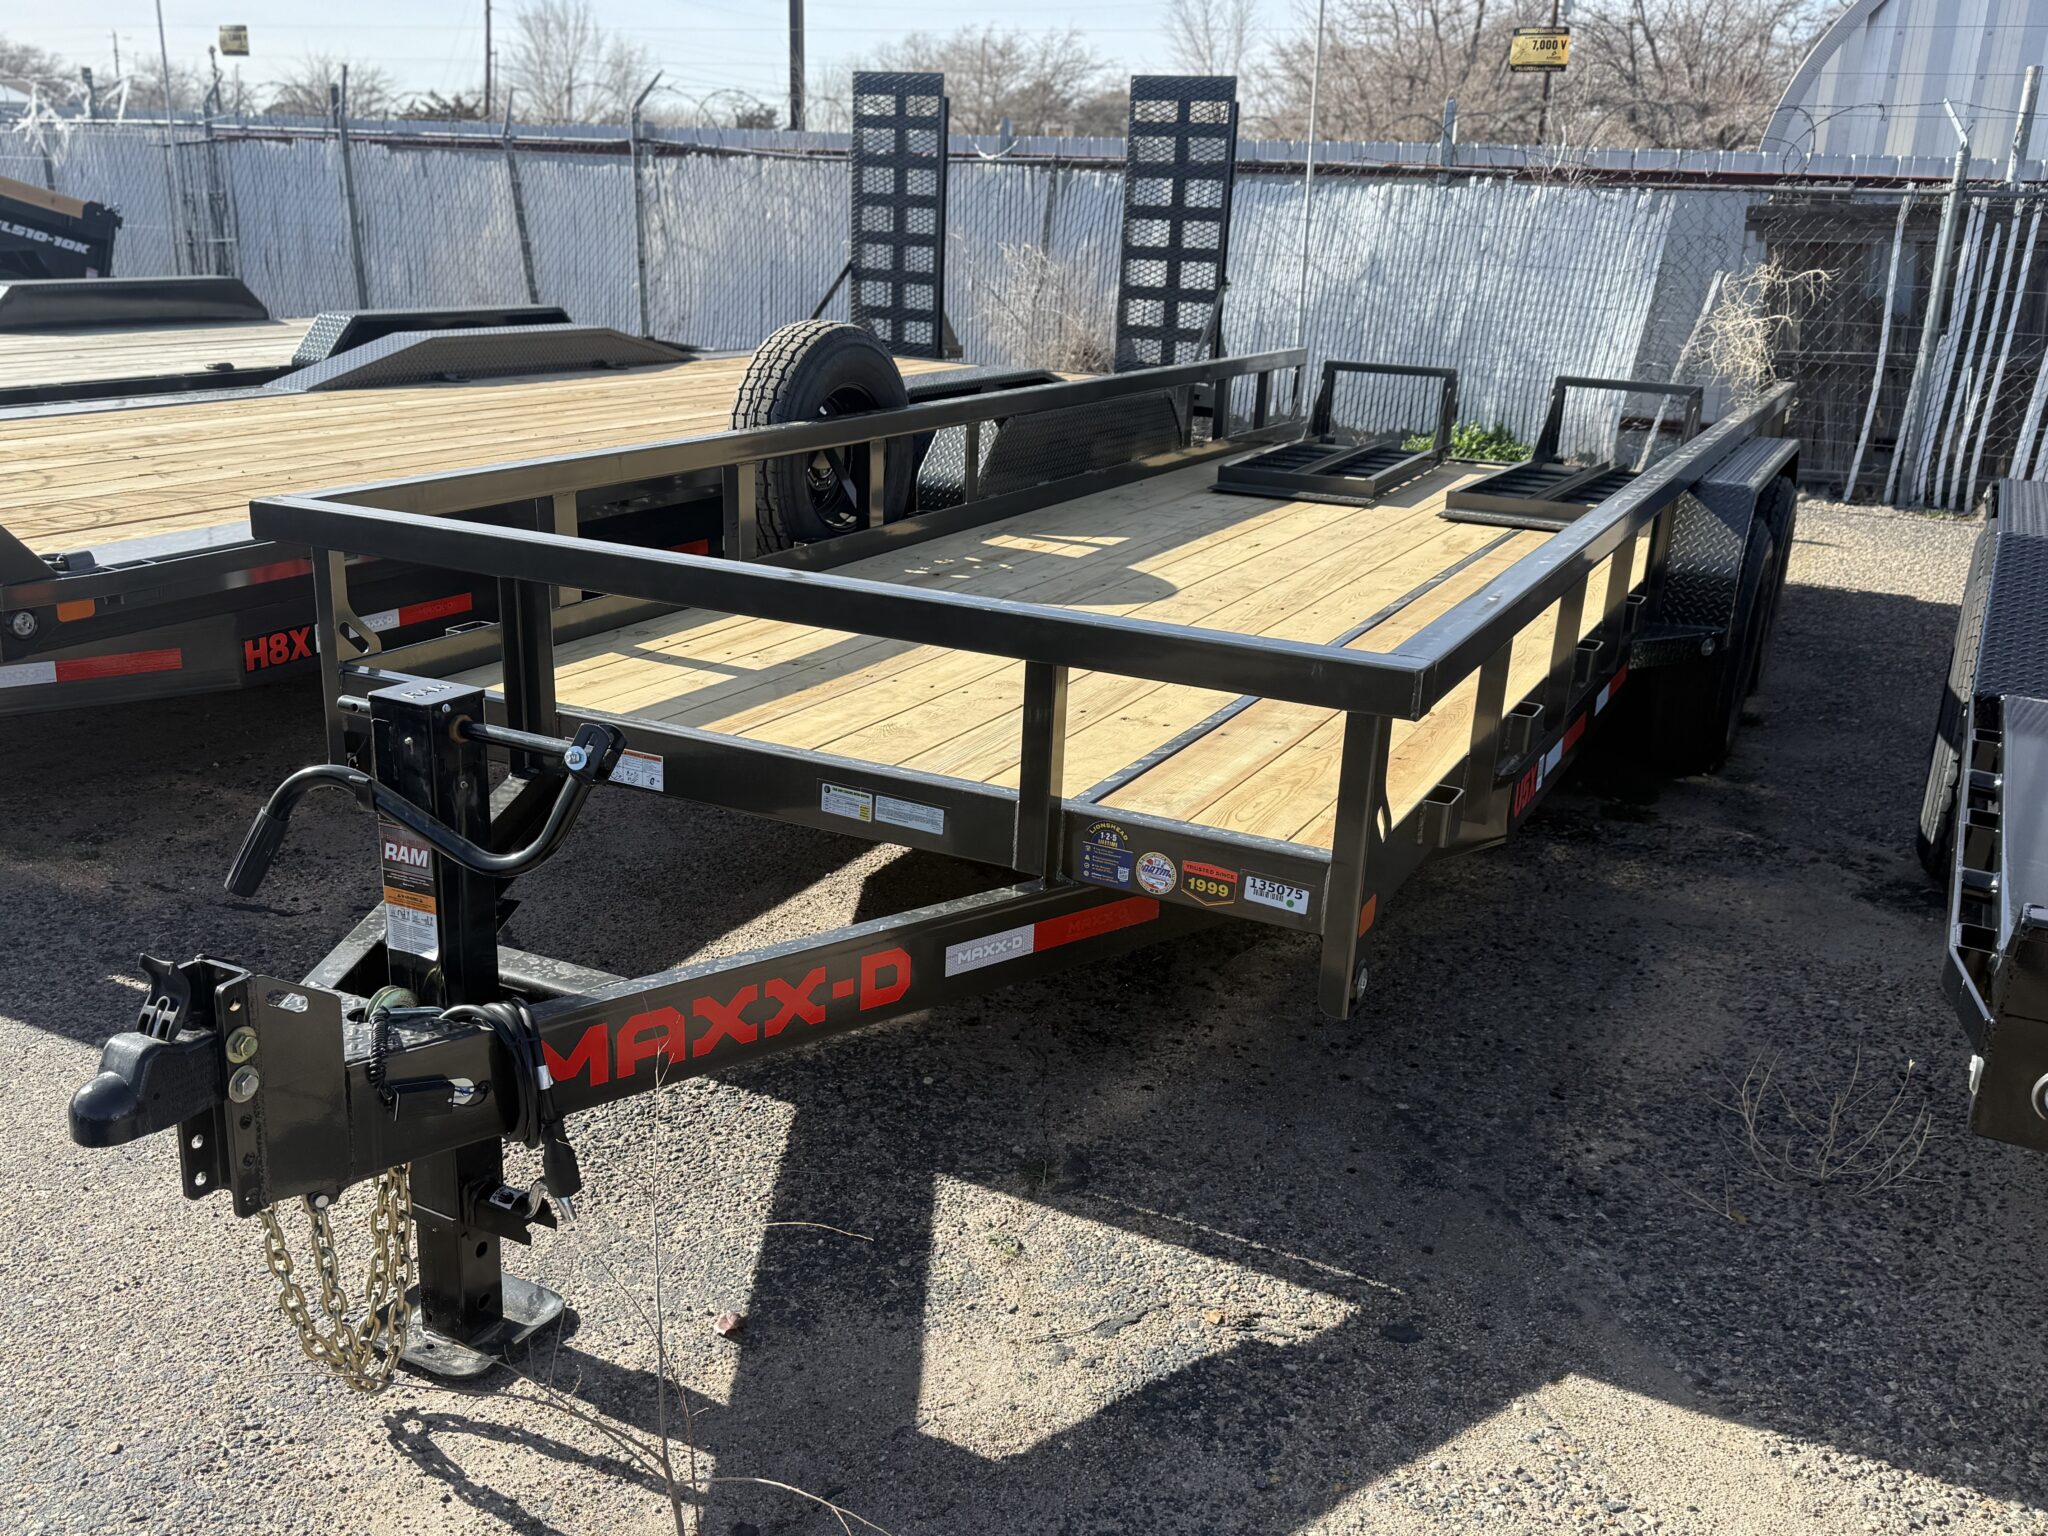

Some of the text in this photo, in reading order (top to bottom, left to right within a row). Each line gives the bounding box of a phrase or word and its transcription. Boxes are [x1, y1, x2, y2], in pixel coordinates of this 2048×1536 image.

[1532, 40, 1568, 51] 7,000 V
[245, 626, 312, 672] H8X
[401, 684, 452, 699] RAM
[1089, 822, 1128, 841] LIONSHEAD
[384, 842, 429, 868] RAM
[1186, 864, 1235, 880] TRUSTED SINCE
[1188, 877, 1229, 897] 1999
[1249, 878, 1303, 900] 135075
[1067, 908, 1128, 934] MAXX-D
[956, 936, 1023, 965] MAXX-D
[541, 947, 911, 1087] MAXX-D
